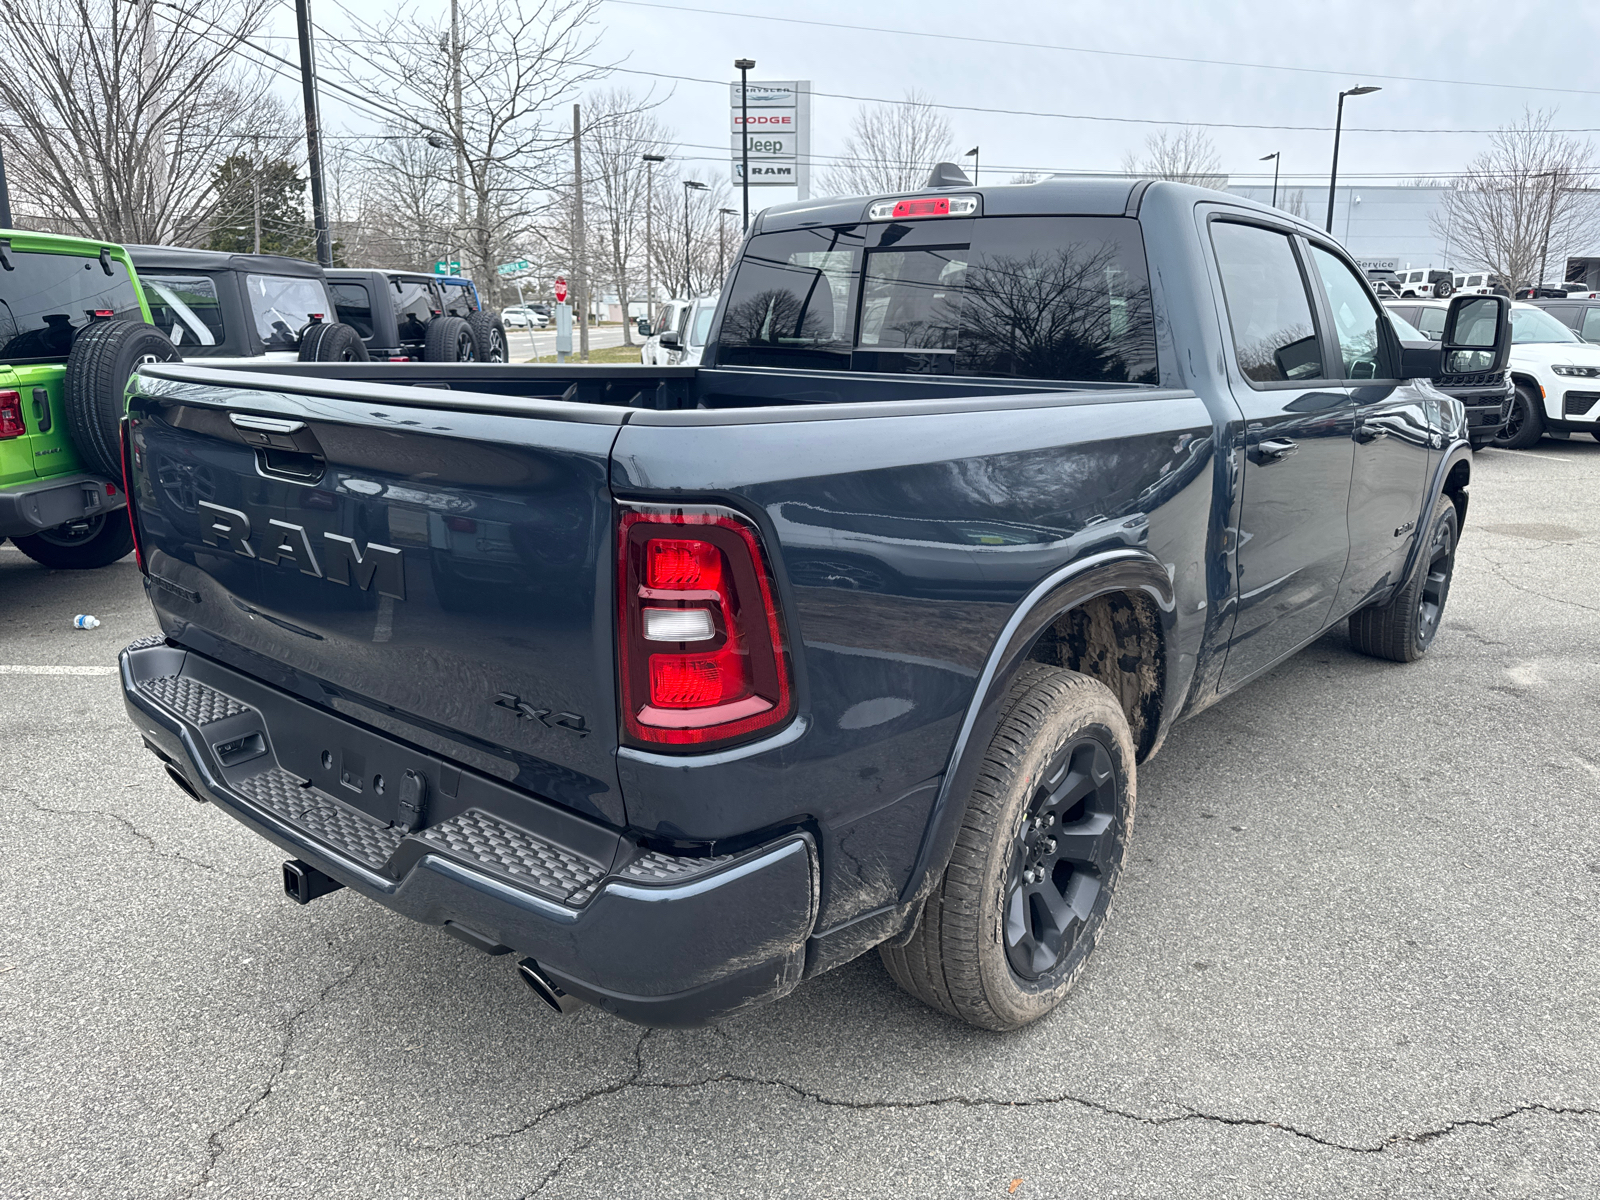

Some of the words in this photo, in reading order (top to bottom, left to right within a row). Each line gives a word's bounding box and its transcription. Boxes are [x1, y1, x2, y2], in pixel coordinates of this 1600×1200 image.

[734, 116, 791, 124] DODGE
[747, 137, 783, 154] Jeep
[752, 167, 791, 175] RAM
[1356, 260, 1394, 269] Service
[555, 283, 567, 294] STOP
[199, 500, 406, 600] RAM
